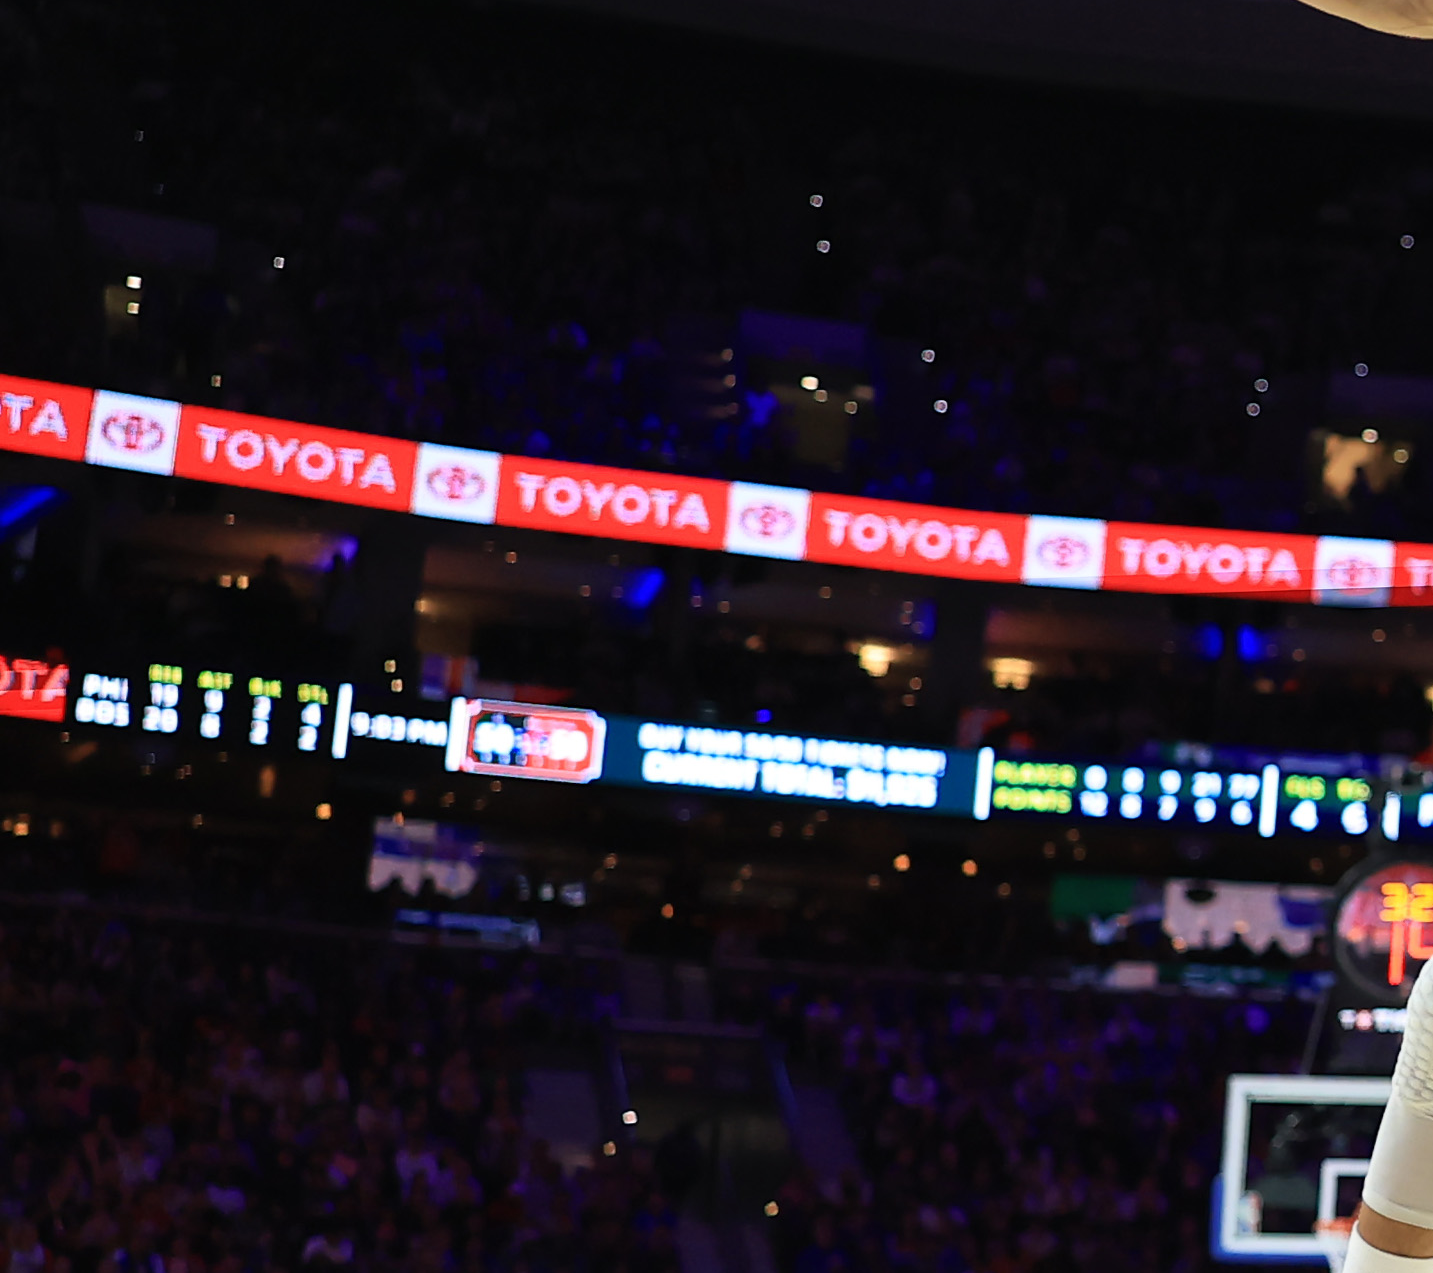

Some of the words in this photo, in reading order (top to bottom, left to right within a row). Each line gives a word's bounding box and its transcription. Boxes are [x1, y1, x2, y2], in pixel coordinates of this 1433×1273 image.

[195, 423, 397, 494] TOYOTA
[514, 471, 711, 534] TOYOTA
[823, 508, 1011, 568] TOYOTA
[1117, 536, 1301, 588] TOYOTA
